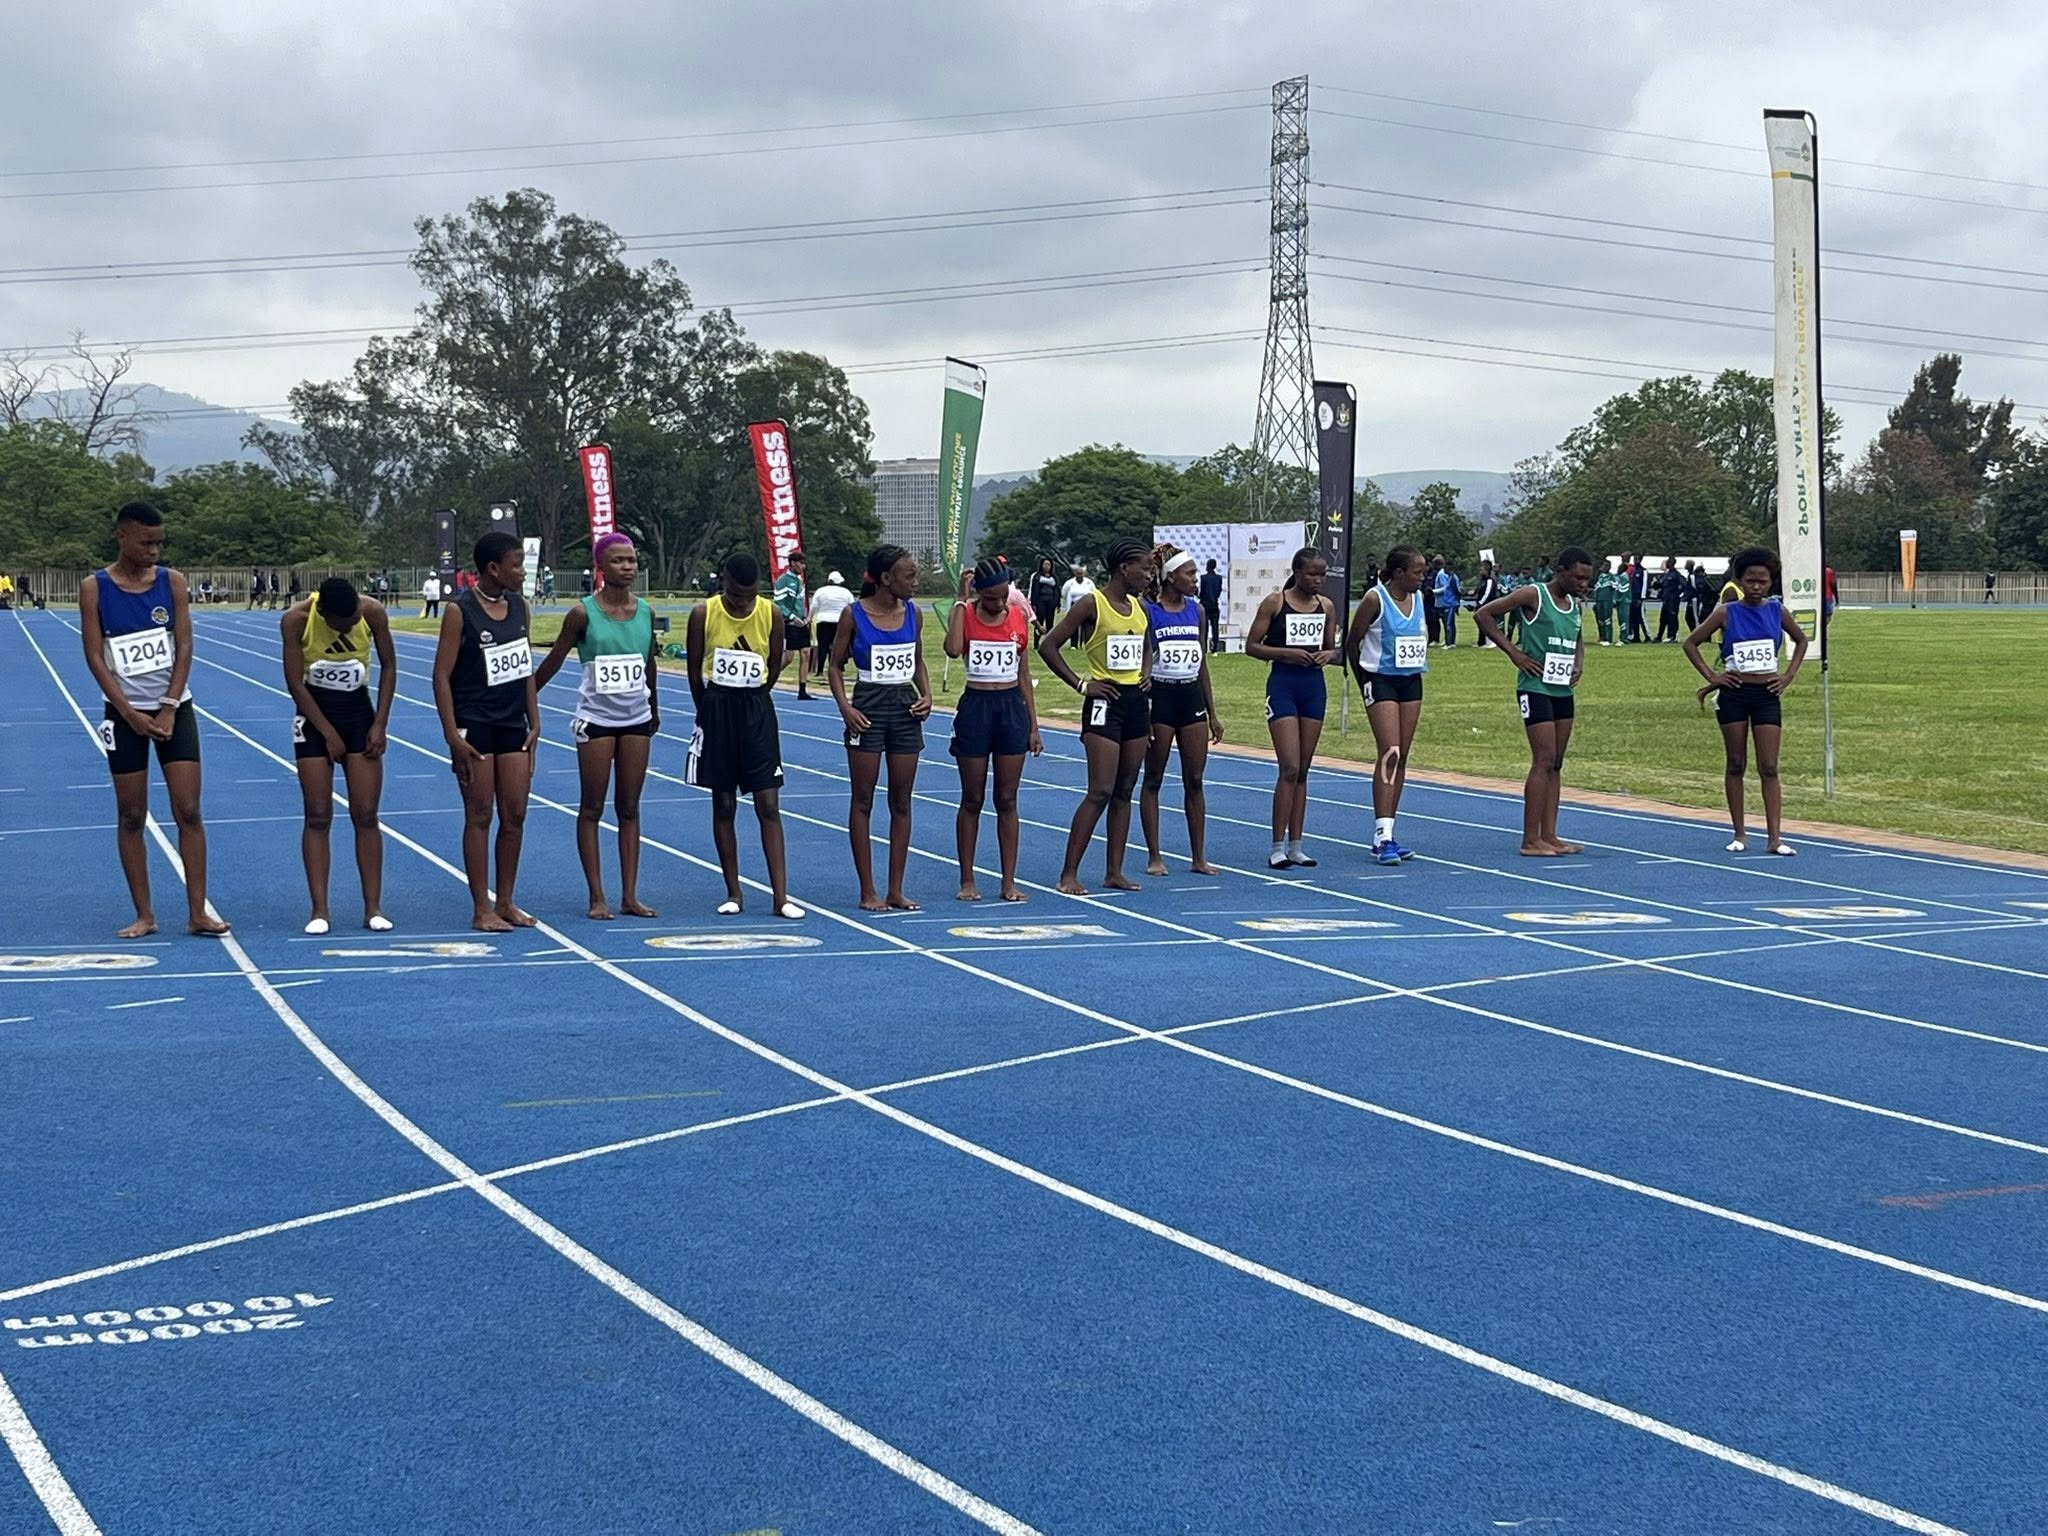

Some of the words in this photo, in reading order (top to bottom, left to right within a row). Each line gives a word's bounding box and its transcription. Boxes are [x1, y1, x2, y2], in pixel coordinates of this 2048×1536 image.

[588, 453, 614, 541] itness
[762, 431, 799, 569] Witness
[1290, 622, 1323, 636] 3809
[118, 639, 167, 665] 1204
[972, 650, 1013, 666] 3913
[1162, 649, 1200, 664] 3578
[1737, 648, 1772, 664] 3455
[491, 649, 529, 675] 3804
[716, 658, 760, 678] 3615
[874, 653, 912, 671] 3955
[1547, 661, 1574, 677] 350
[313, 668, 360, 683] 3621
[600, 665, 642, 682] 3510
[1093, 705, 1103, 721] 7
[18, 1313, 305, 1348] 2000m
